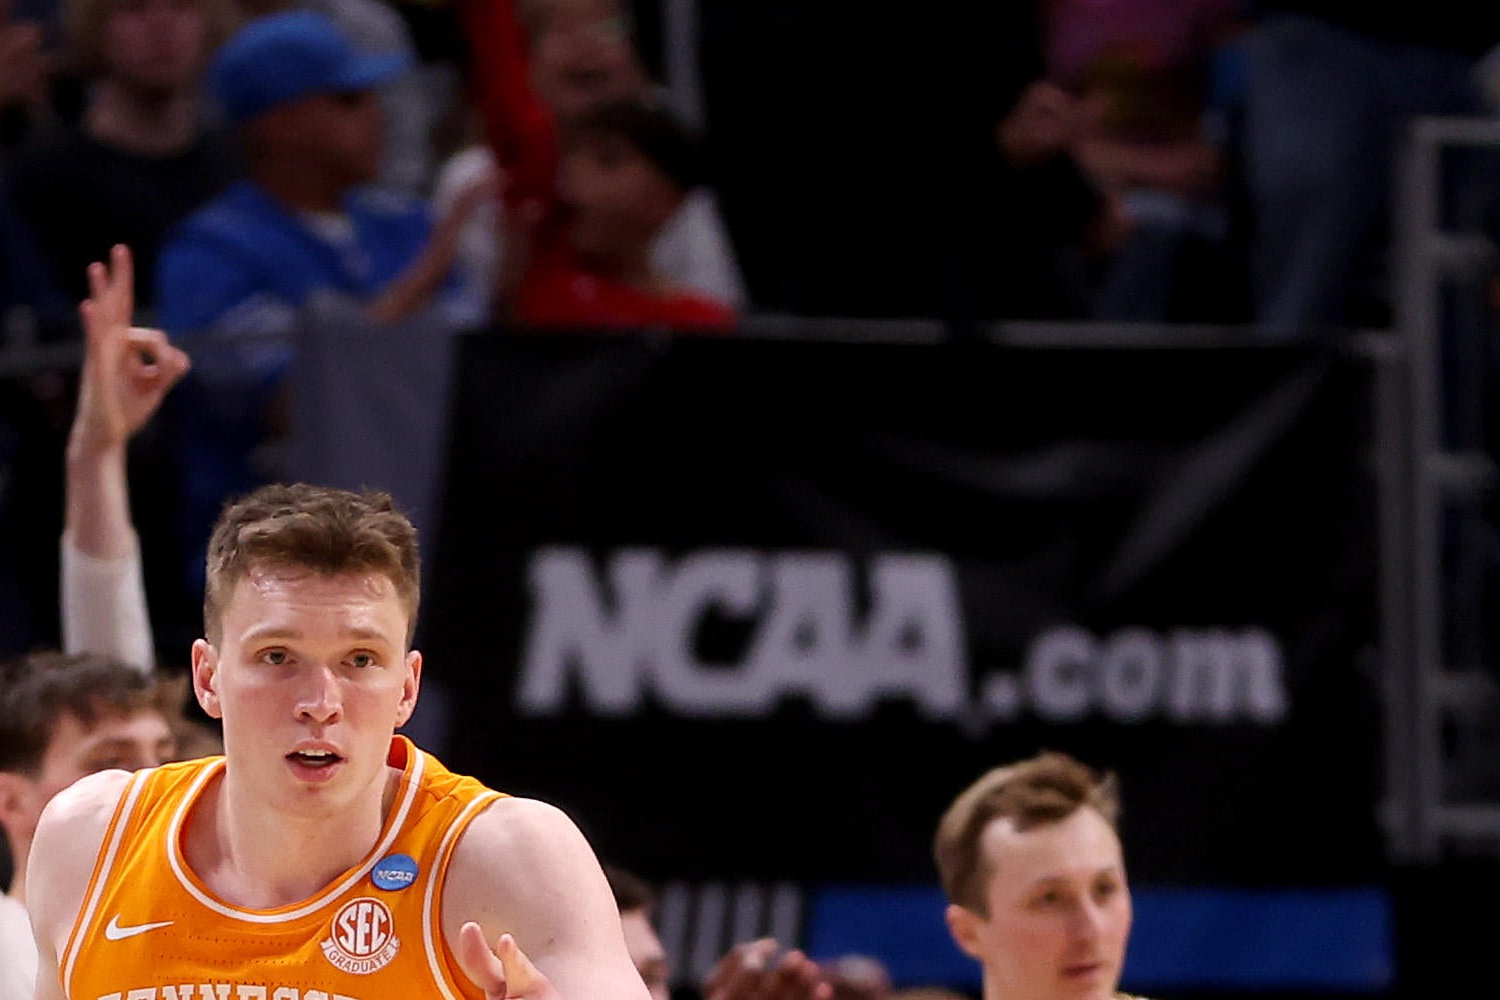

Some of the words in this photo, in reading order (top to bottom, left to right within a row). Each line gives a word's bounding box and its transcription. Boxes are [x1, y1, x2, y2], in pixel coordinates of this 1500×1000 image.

[517, 547, 1288, 721] NCAA.com
[338, 902, 388, 955] SEC
[328, 949, 392, 973] GRADUATE
